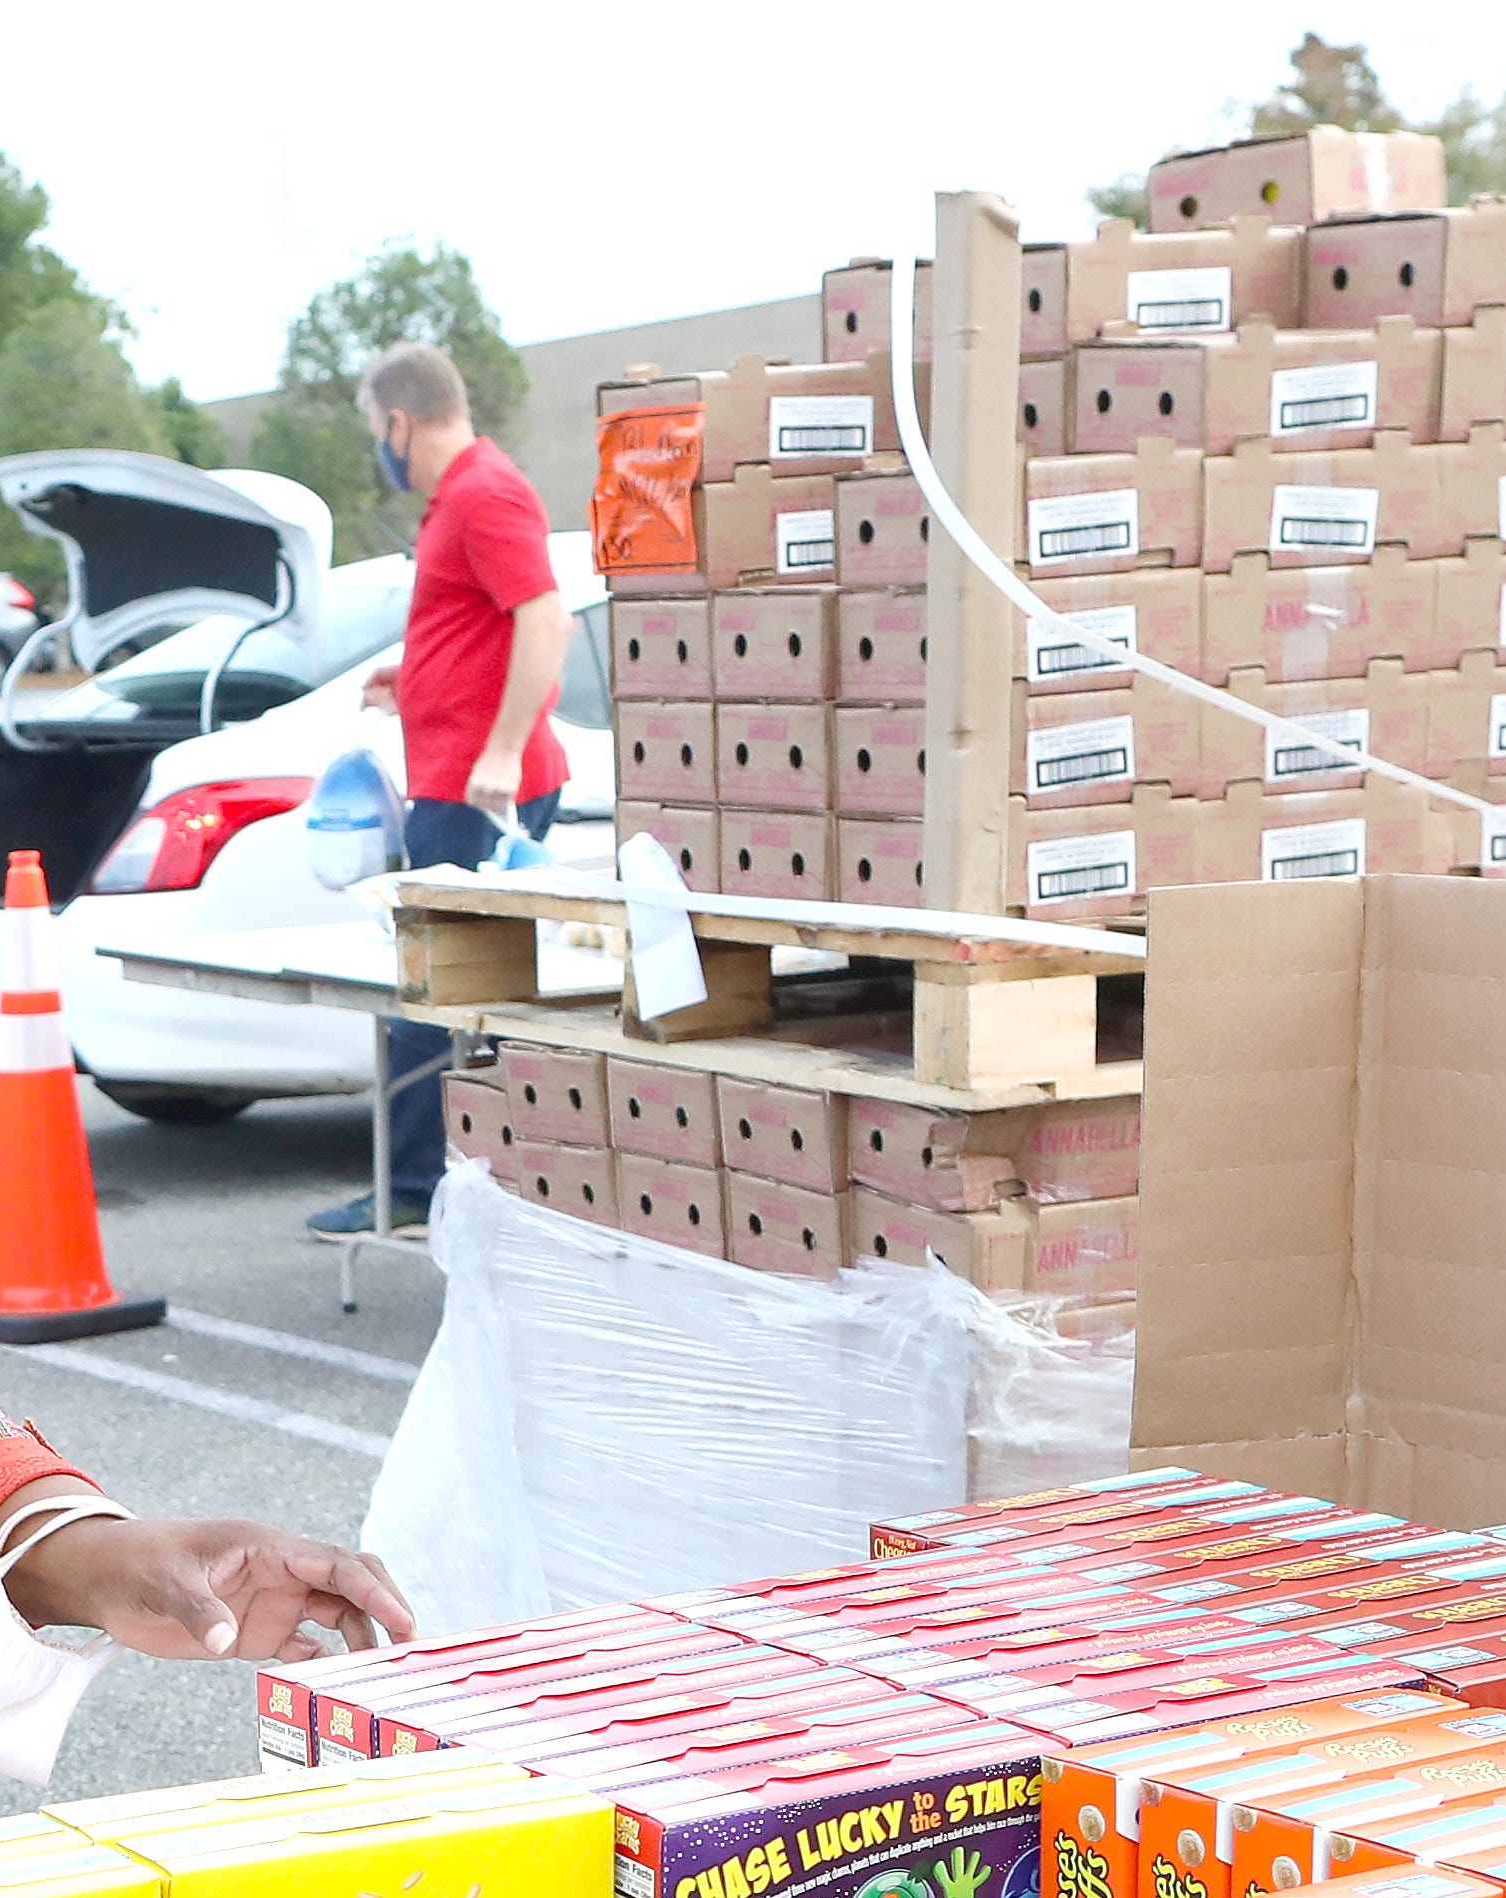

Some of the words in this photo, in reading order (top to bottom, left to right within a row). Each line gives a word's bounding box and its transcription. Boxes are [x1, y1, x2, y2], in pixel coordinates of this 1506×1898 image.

[913, 1791, 934, 1812] to
[945, 1774, 1043, 1822] STARS
[796, 1801, 905, 1871] LUCKY
[910, 1810, 942, 1834] the
